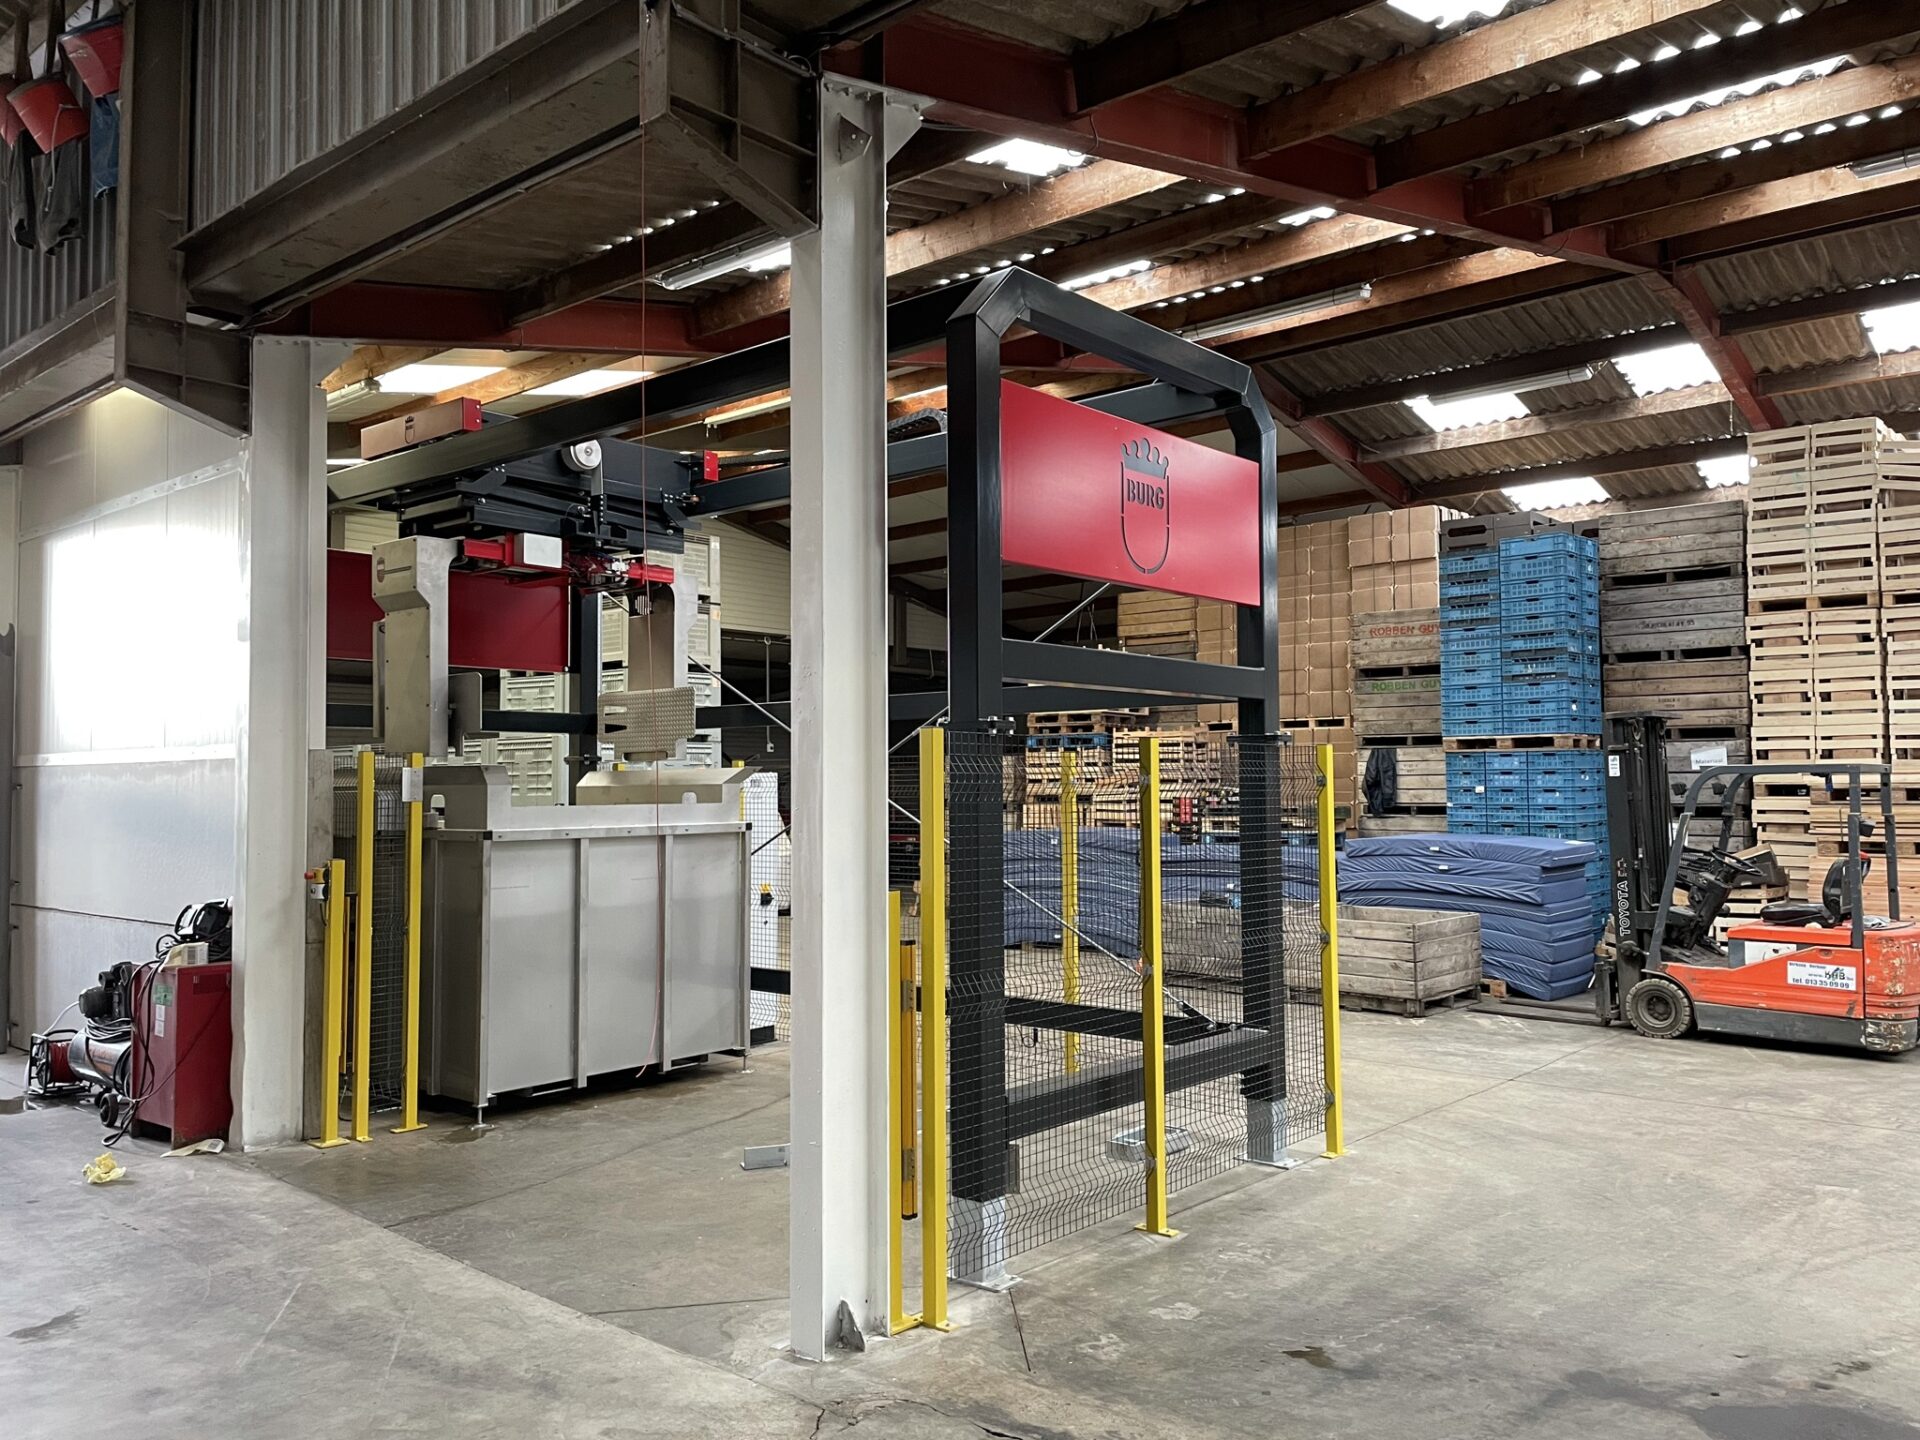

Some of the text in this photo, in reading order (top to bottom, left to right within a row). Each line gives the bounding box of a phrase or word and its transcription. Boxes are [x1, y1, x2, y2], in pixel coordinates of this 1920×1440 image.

[1126, 478, 1165, 510] BURG
[1369, 625, 1416, 638] ROBBEN
[1371, 681, 1416, 692] ROBBEN
[1616, 880, 1631, 937] TOYOTA
